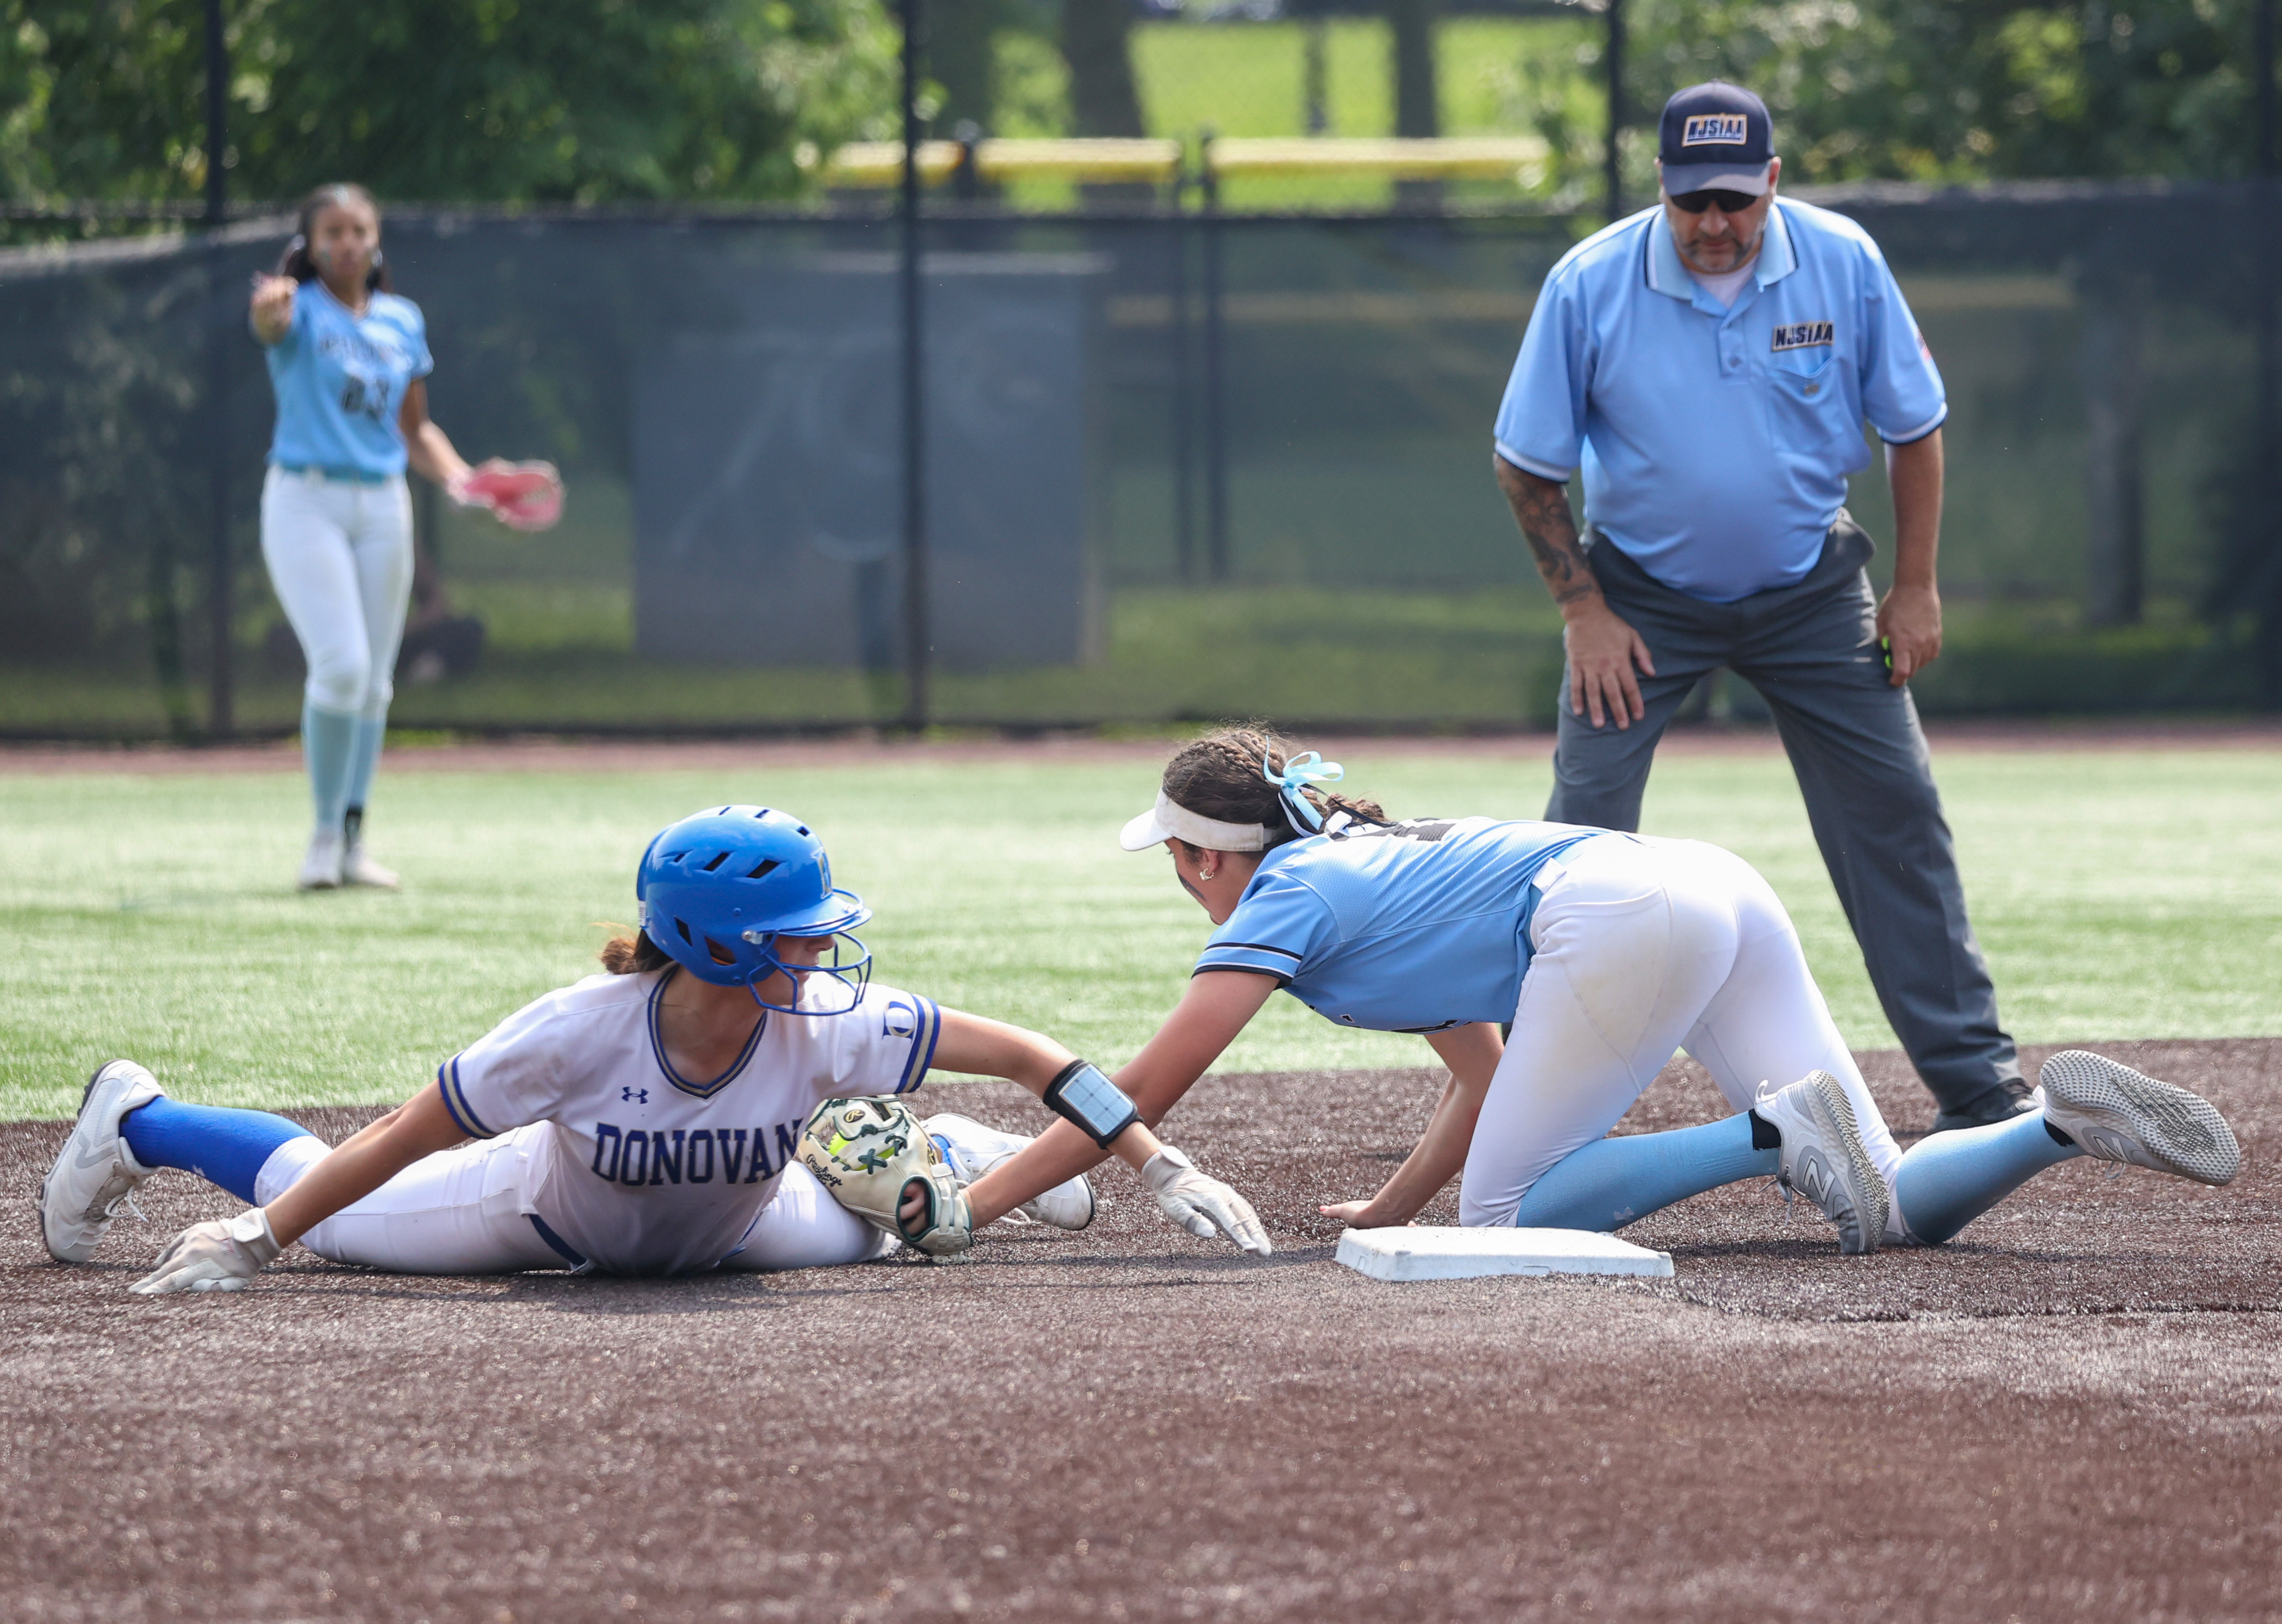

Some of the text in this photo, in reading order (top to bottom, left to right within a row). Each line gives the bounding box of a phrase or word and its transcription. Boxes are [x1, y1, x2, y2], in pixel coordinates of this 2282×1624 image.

[1688, 119, 1742, 136] NJSIAA
[1775, 324, 1833, 346] NJSIAA
[882, 1001, 916, 1044] D
[806, 1154, 843, 1187] Rawlings
